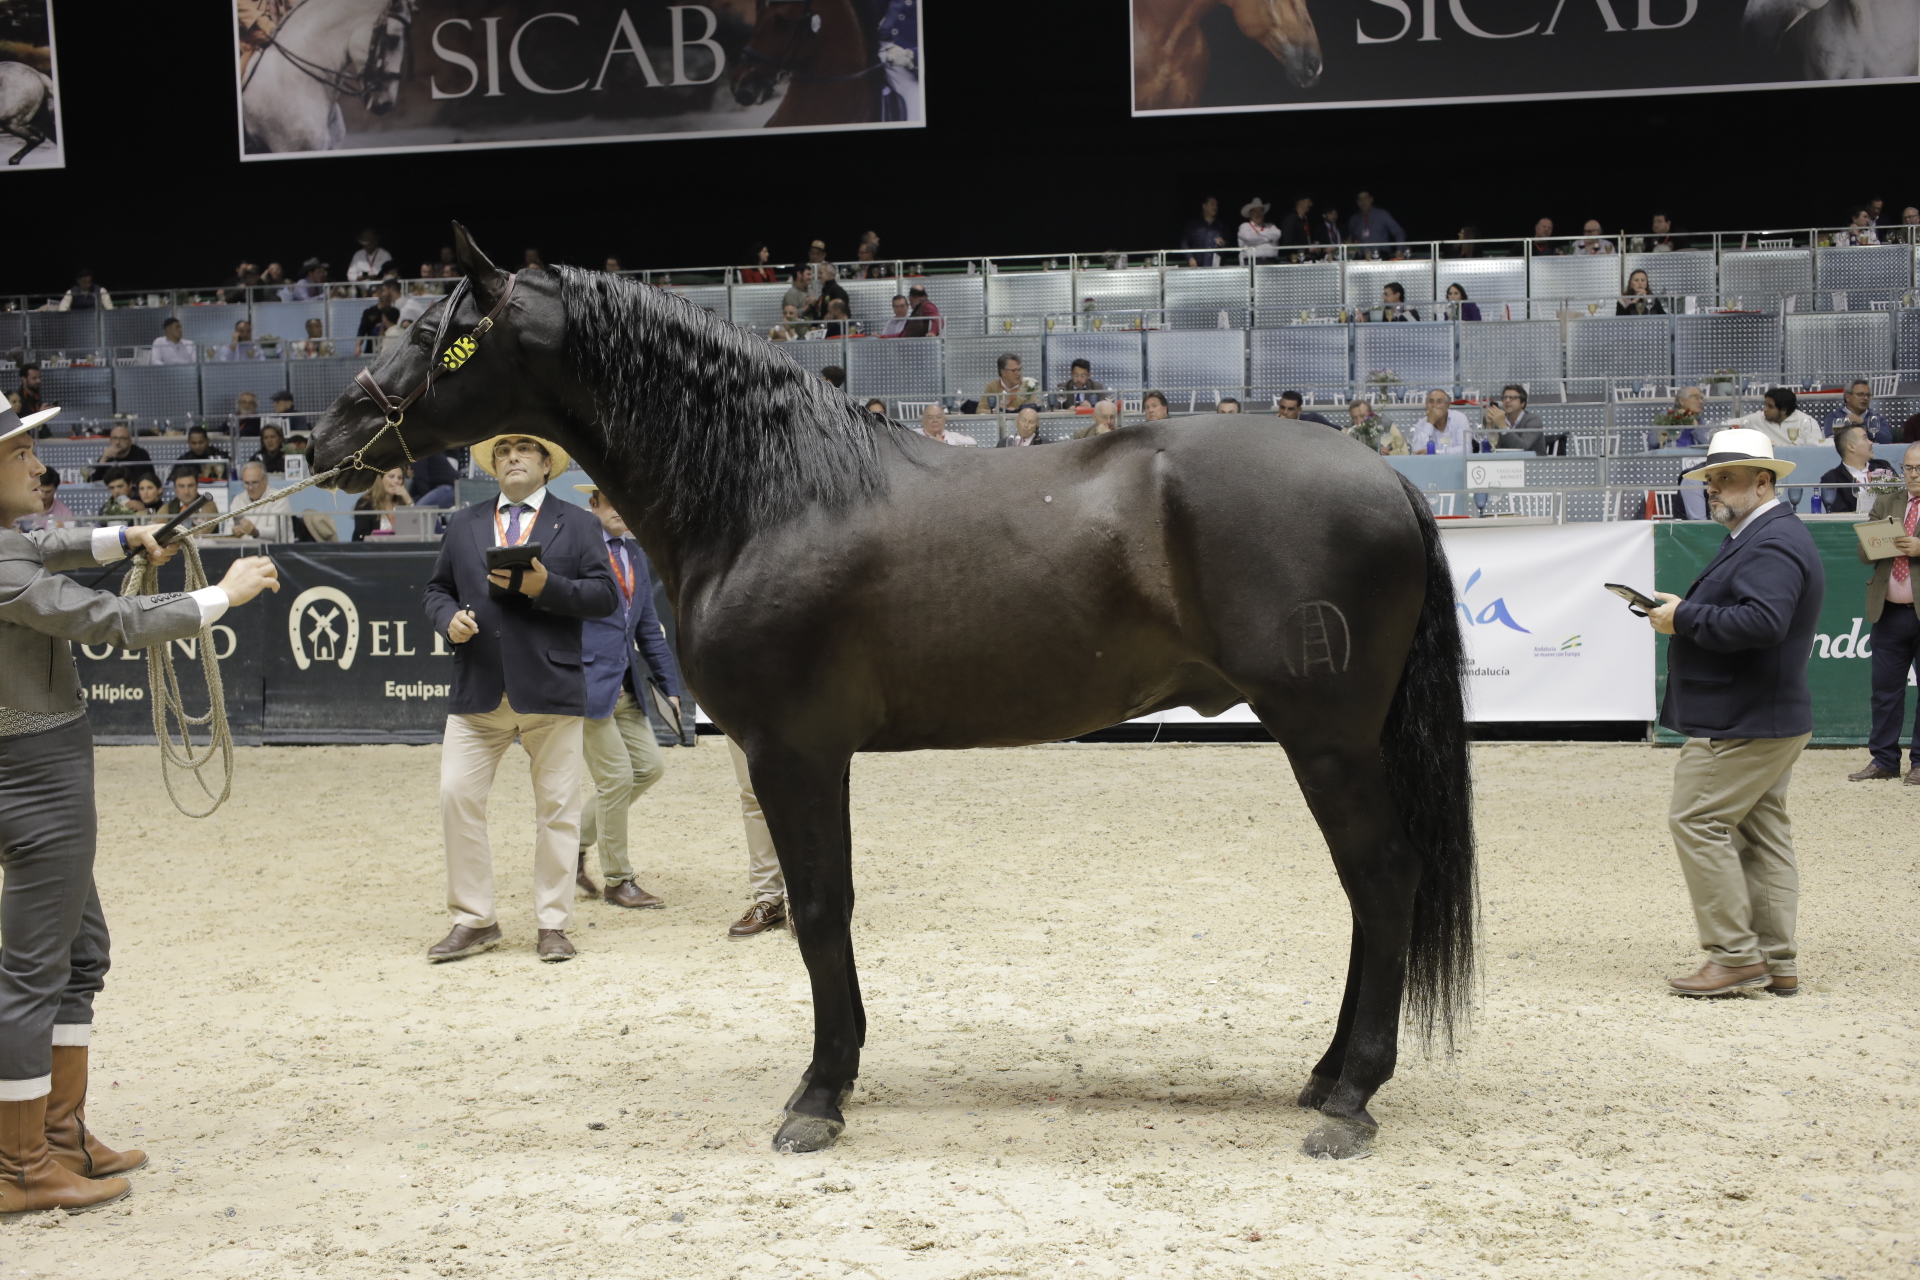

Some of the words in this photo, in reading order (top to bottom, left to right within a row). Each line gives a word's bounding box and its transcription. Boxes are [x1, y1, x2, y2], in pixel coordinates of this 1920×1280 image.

[431, 5, 726, 99] SICAB
[442, 334, 479, 372] 803
[368, 620, 416, 656] EL
[92, 684, 144, 704] Hípico
